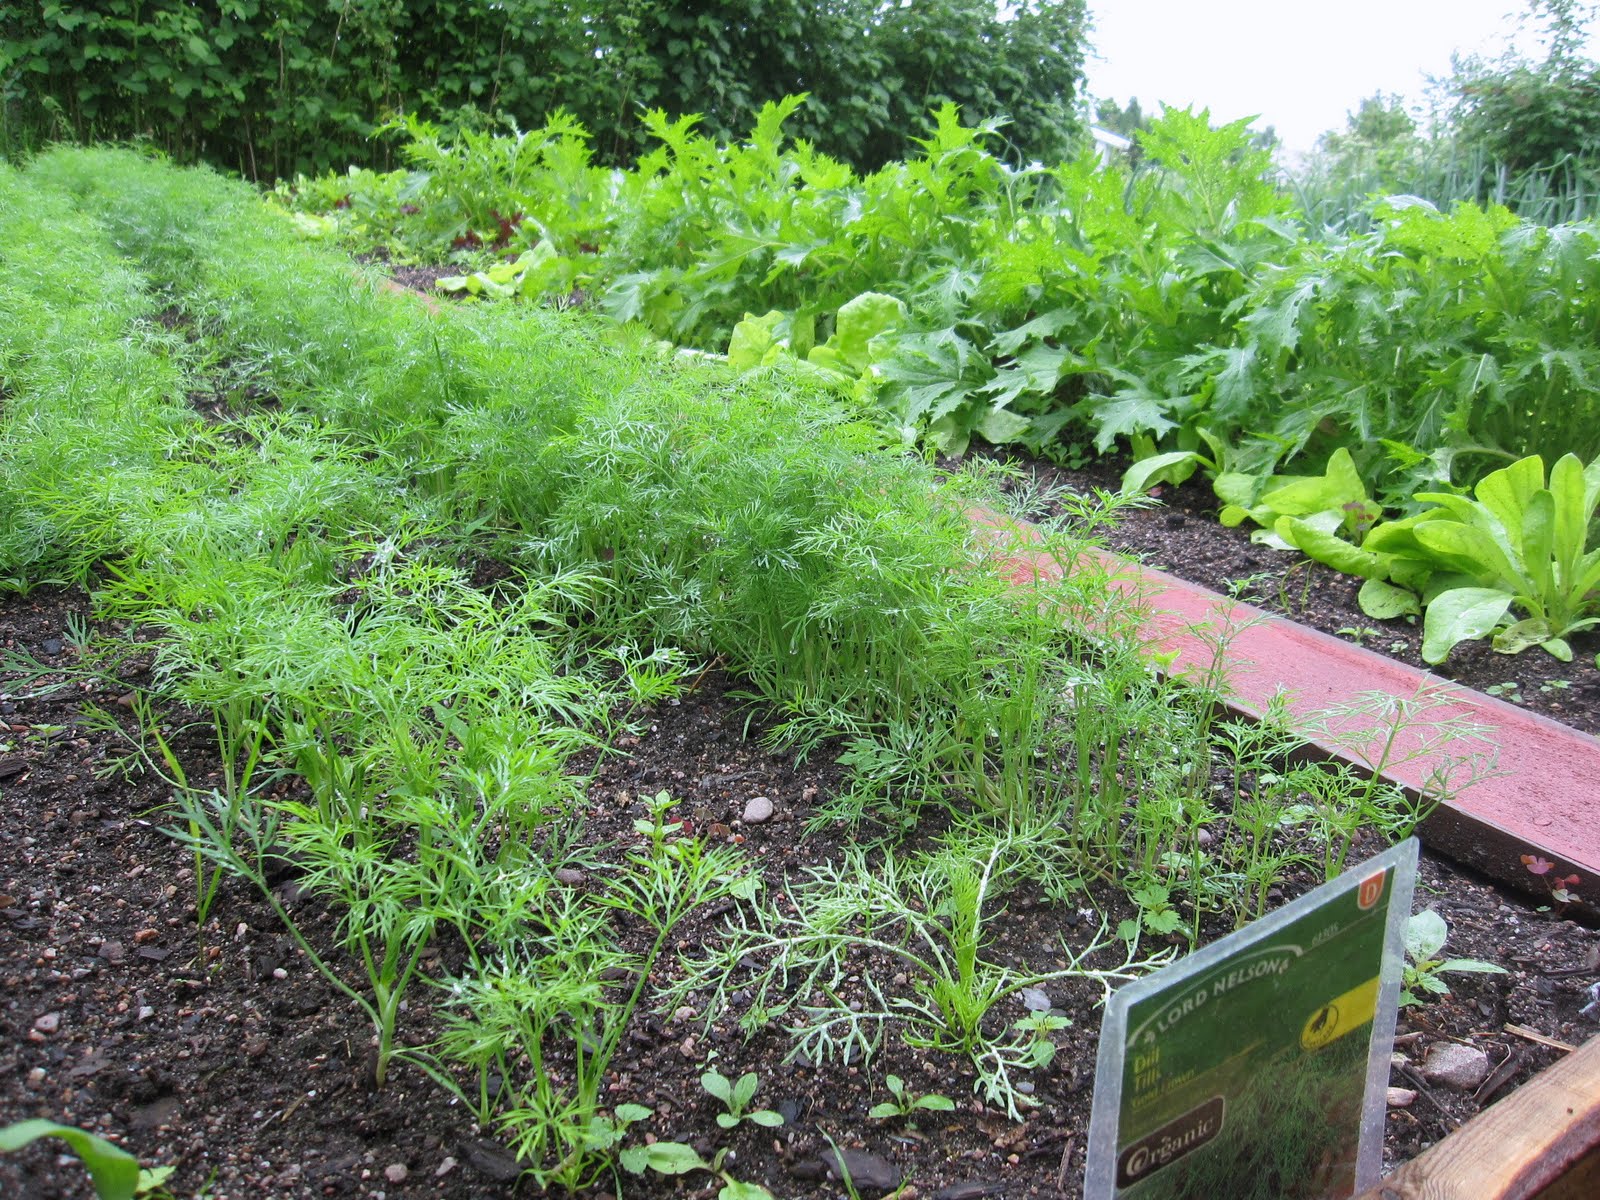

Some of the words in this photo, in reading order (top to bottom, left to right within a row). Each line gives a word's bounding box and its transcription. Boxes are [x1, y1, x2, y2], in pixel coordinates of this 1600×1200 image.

[1157, 990, 1208, 1033] LORD
[1213, 958, 1281, 996] NELSON
[1126, 1117, 1214, 1177] Organic
